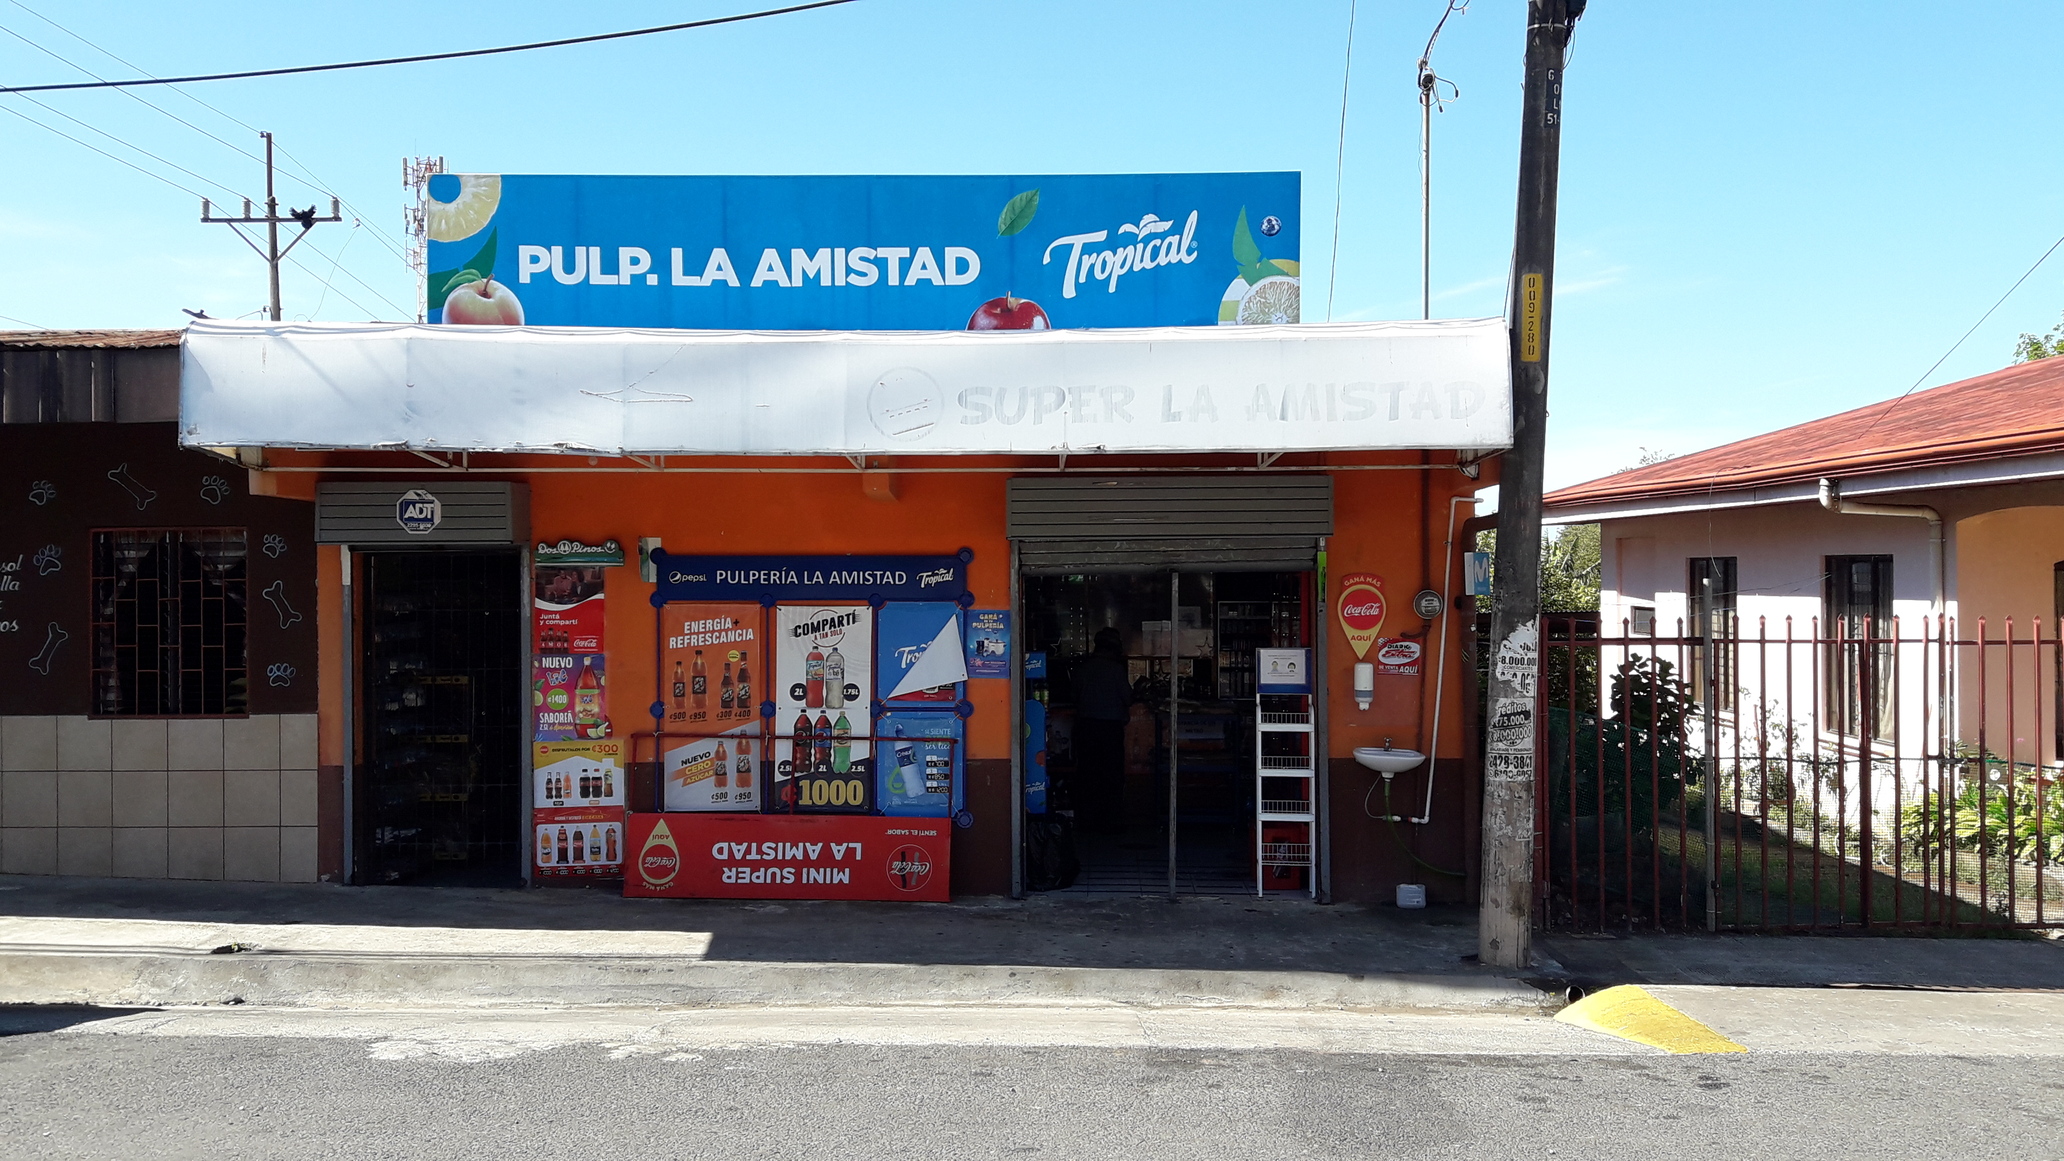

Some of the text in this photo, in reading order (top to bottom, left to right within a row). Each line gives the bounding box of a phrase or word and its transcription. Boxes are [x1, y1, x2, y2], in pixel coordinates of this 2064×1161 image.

[1042, 208, 1199, 300] Tropical
[518, 244, 981, 288] PULP. LA AMISTAD
[956, 379, 1489, 426] SUPER LA AMISTAD
[403, 503, 435, 519] ADT
[571, 542, 605, 553] Pinos
[682, 567, 954, 588] pepsi PULPERÍA LA AMISTAD Tropical
[1344, 575, 1382, 588] GANÁ MÁS
[684, 615, 732, 634] ENERGÍA
[793, 609, 857, 638] COMPARTÍ
[669, 628, 754, 649] REFRESCANCIA
[1350, 633, 1372, 642] AQUÍ
[542, 657, 573, 668] NUEVO
[1399, 664, 1418, 674] AQUÍ
[793, 688, 804, 696] 2L
[539, 711, 574, 723] SABOREÁ
[681, 751, 711, 766] NUEVO
[685, 760, 711, 775] CERO
[686, 770, 714, 784] AZÚCAR
[798, 779, 864, 806] 1000
[918, 828, 937, 836] SENTÍ
[711, 841, 862, 861] LA AMISTAD
[721, 867, 850, 884] MINI SUPER
